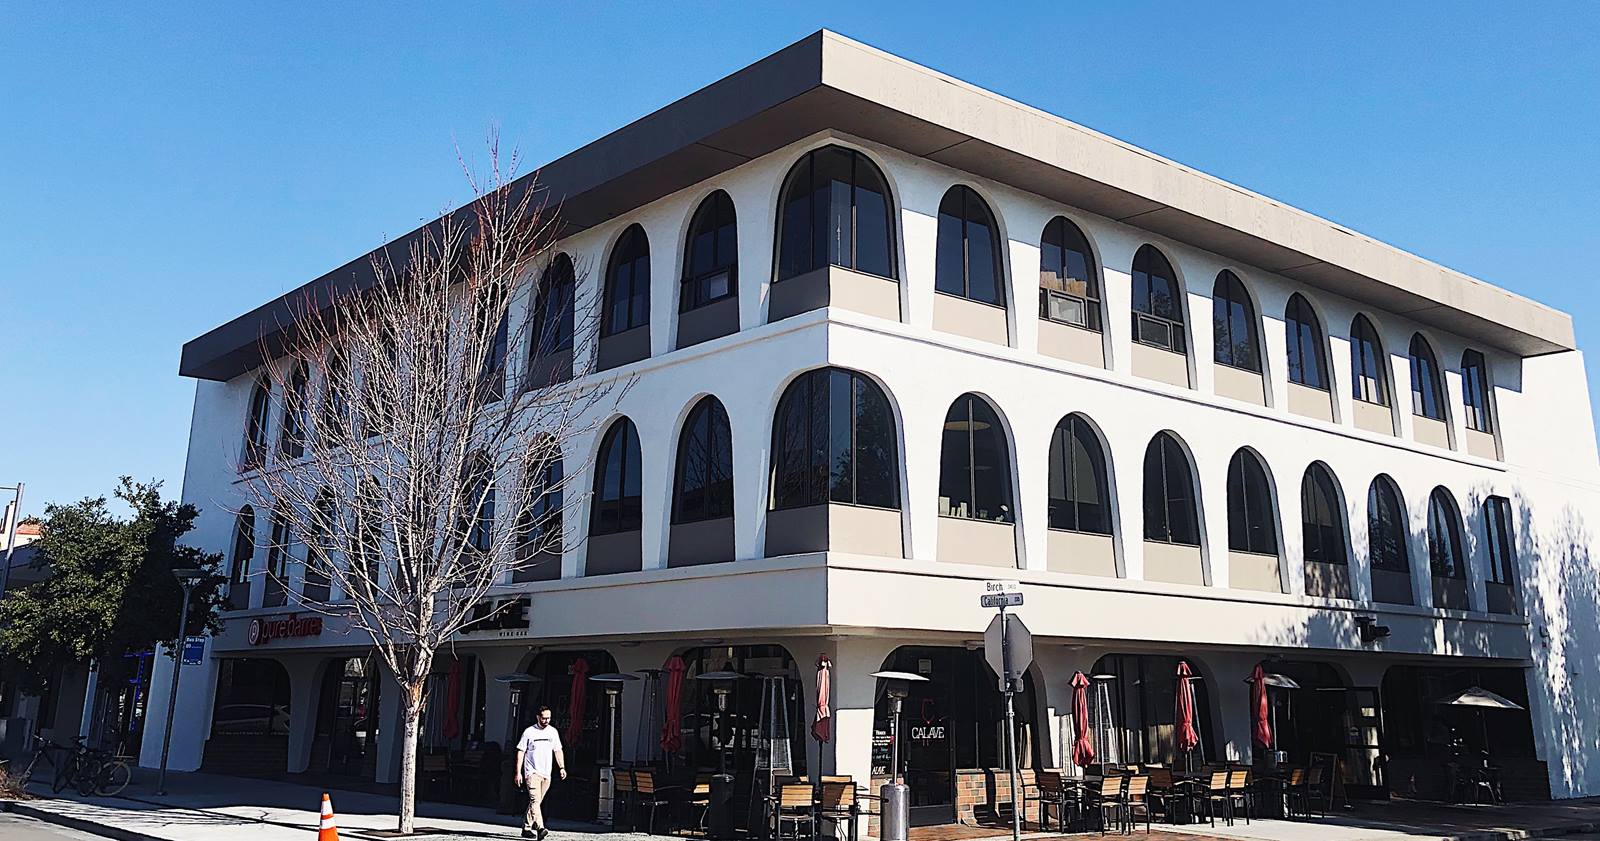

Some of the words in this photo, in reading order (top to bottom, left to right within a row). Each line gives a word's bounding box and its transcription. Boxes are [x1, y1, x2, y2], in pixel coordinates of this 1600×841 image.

[986, 582, 1003, 592] Birch
[984, 596, 1009, 606] California
[911, 726, 945, 739] CALAVE
